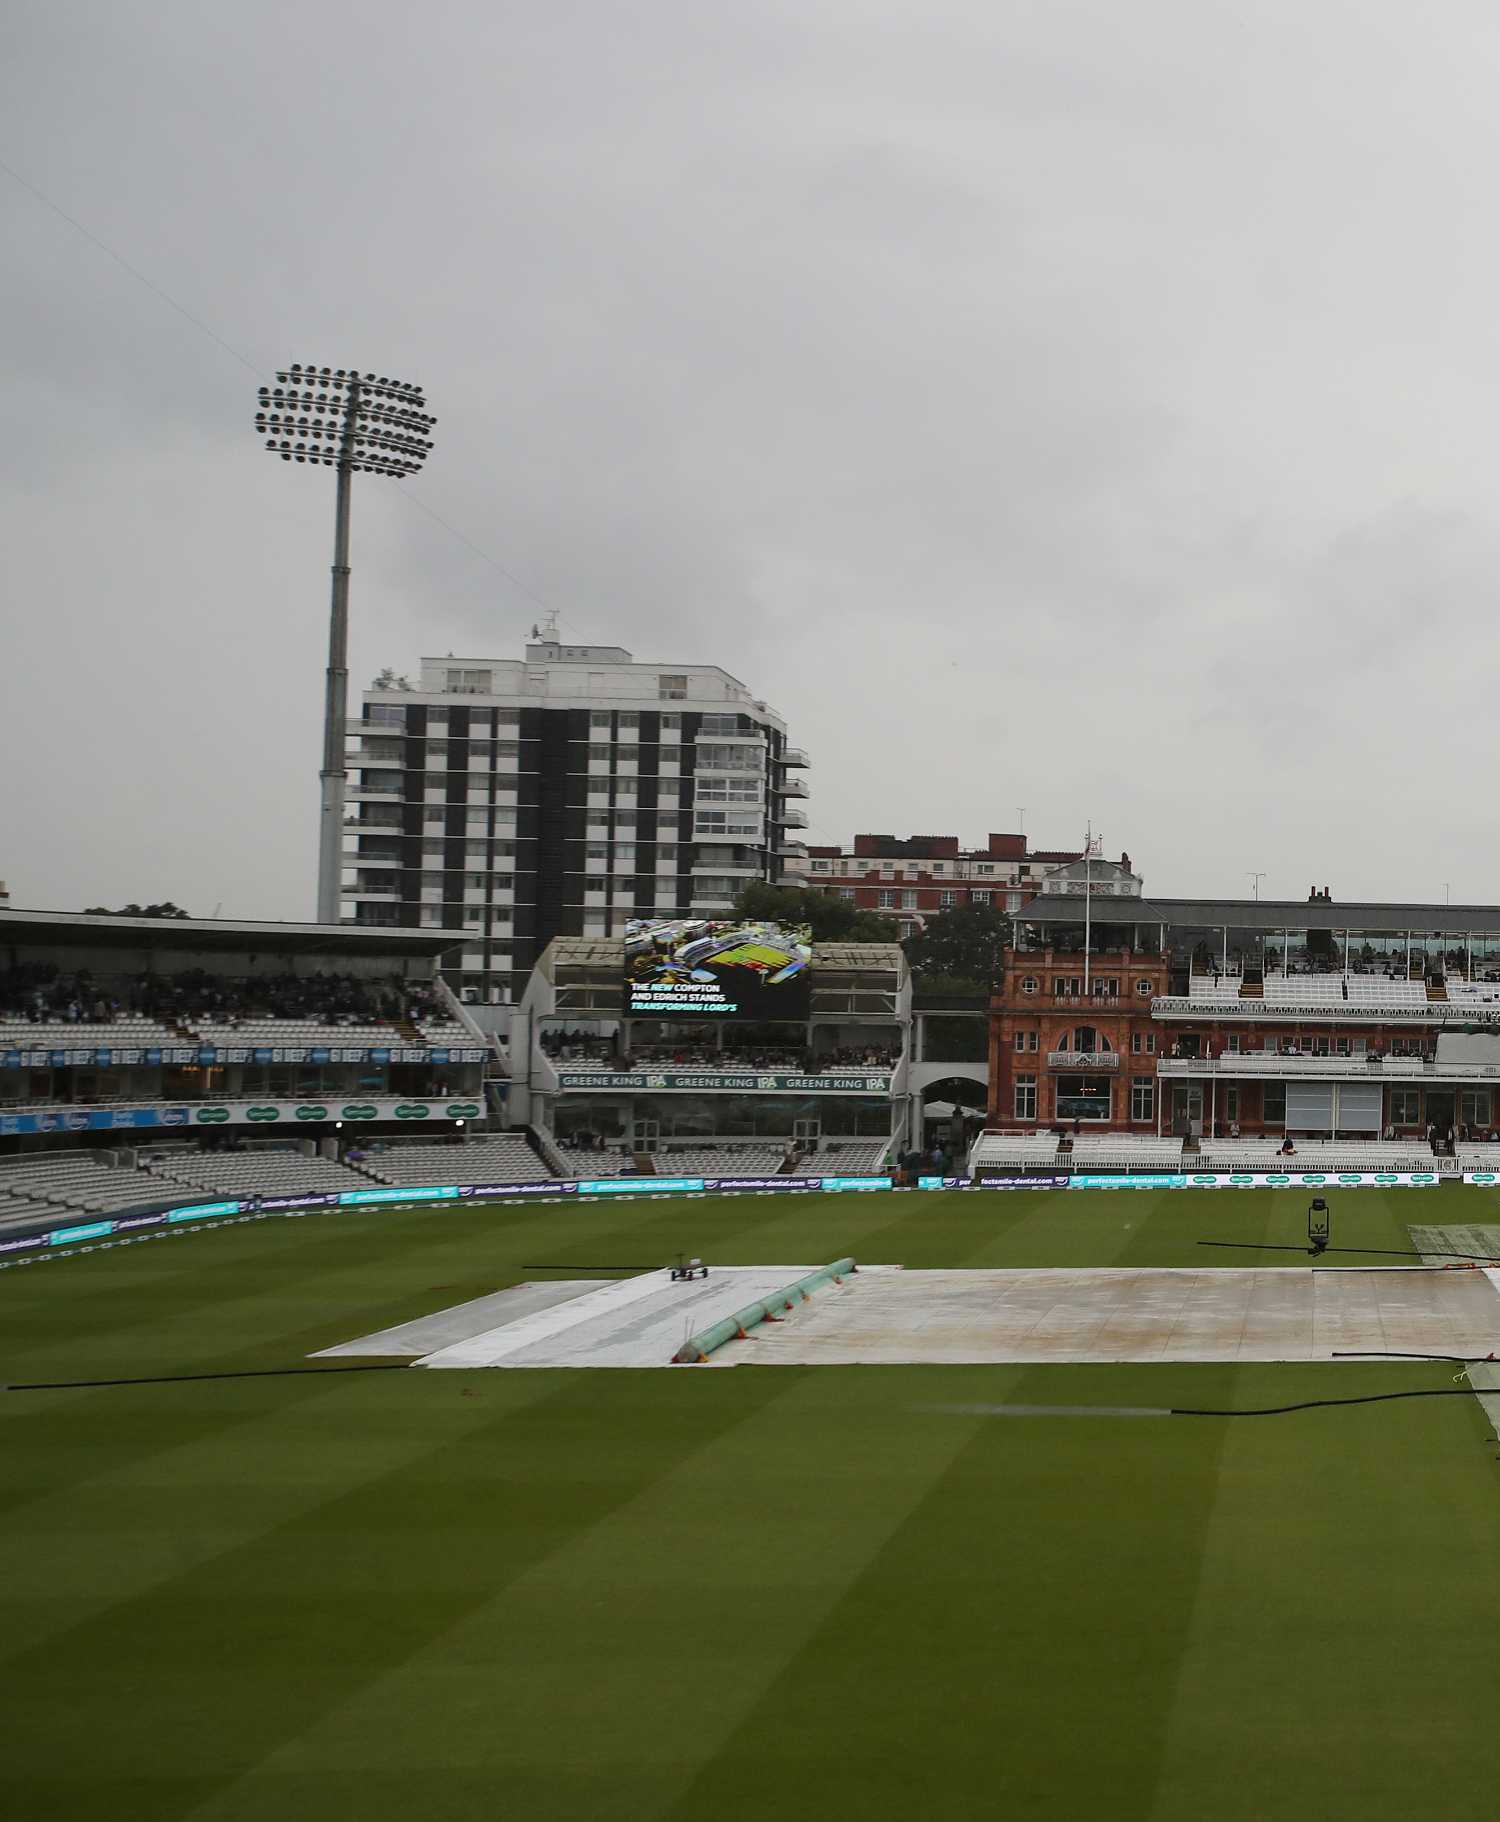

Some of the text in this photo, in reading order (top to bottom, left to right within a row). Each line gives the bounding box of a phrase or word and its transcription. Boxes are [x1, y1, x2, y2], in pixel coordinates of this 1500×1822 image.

[631, 983, 721, 992] THE NEW COMPTON
[631, 993, 726, 1002] AND EDRICH STANDS
[631, 1002, 738, 1012] TRANSFORMING LORD'S
[562, 1075, 667, 1088] GREENE KING IPA
[675, 1076, 777, 1088] GREENE KING IPA
[786, 1078, 886, 1090] GREENE KING IPA
[1087, 1176, 1169, 1185] perfectsmile-dental.com
